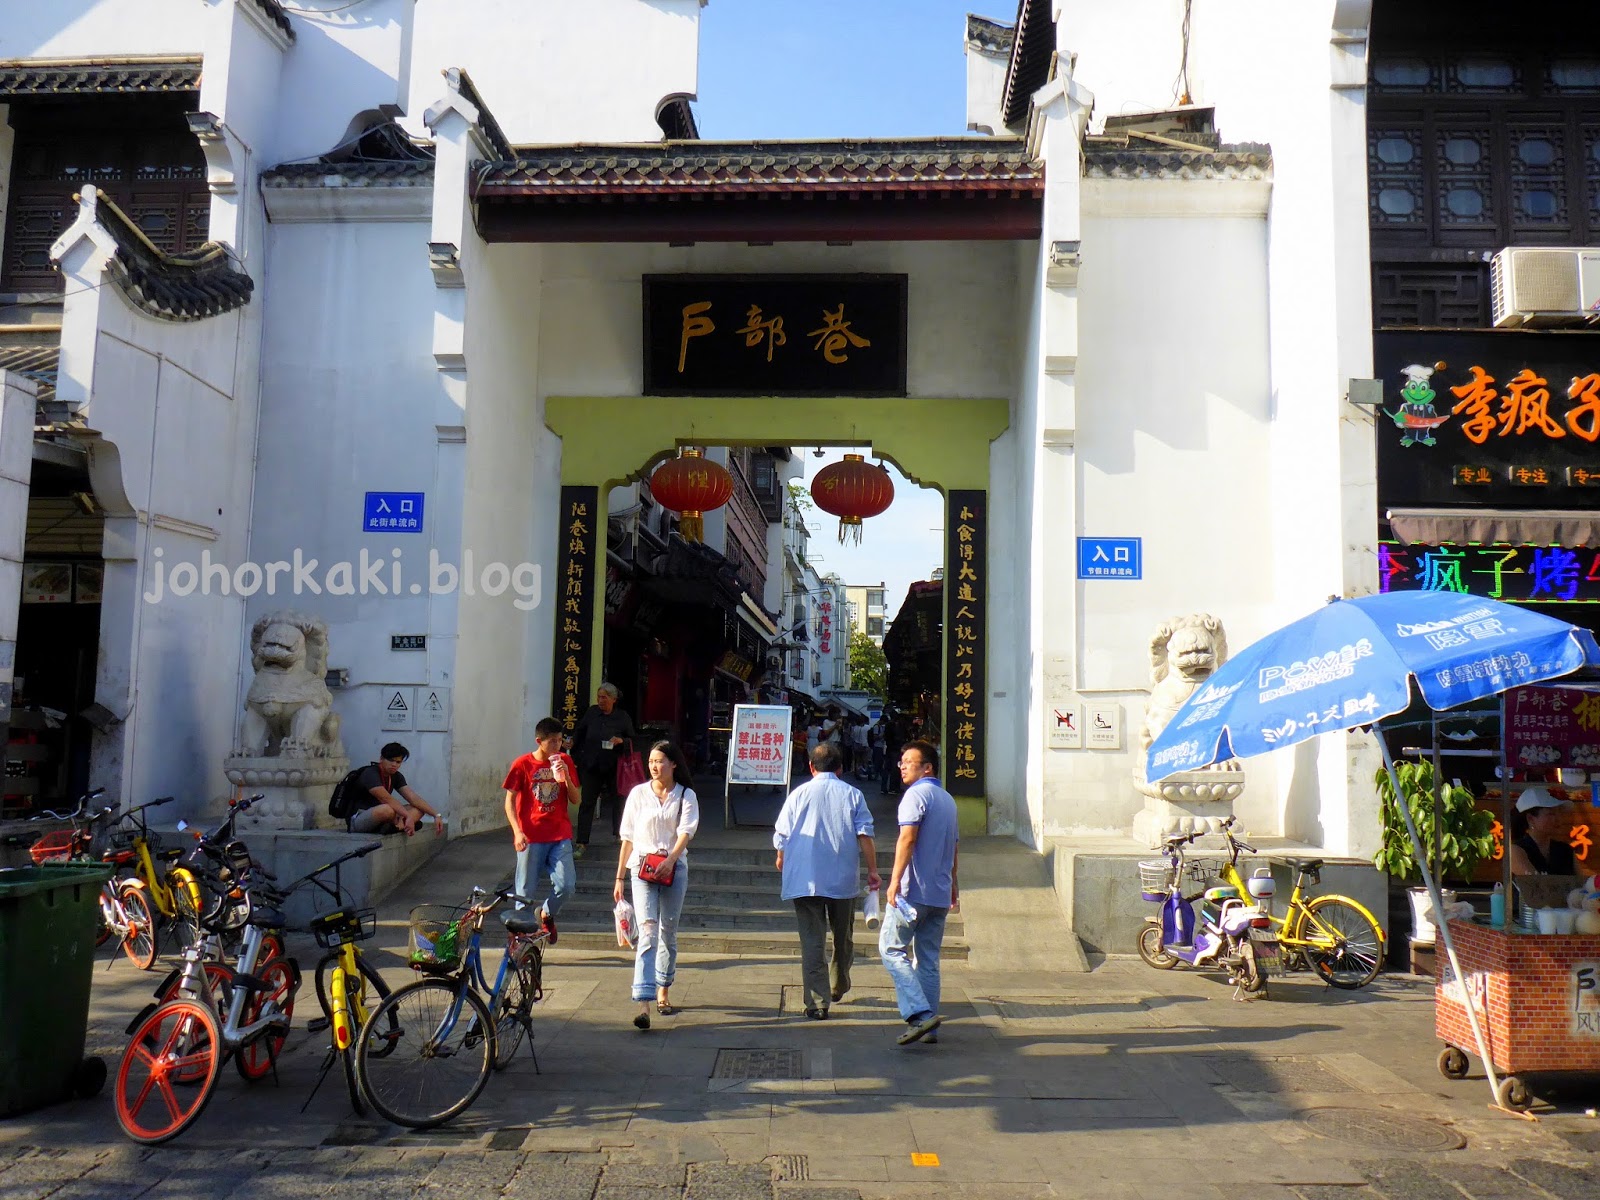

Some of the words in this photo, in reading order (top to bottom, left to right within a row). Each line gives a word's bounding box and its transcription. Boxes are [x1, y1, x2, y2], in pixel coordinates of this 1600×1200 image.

[677, 300, 871, 373] 户部巷
[1450, 365, 1600, 445] 李疯子
[1459, 468, 1492, 484] 专业
[1516, 468, 1549, 484] 专注
[376, 498, 414, 513] 入口
[369, 517, 417, 528] 此街单流向
[1092, 545, 1129, 562] 入口
[1087, 567, 1133, 576] 节假日单流向
[1378, 546, 1600, 600] 李疯子烤
[1425, 617, 1506, 651] 隐雪
[1259, 638, 1374, 689] POWER
[1516, 690, 1568, 713] 户部巷
[738, 731, 785, 747] 禁止各种
[737, 746, 784, 761] 车辆进入
